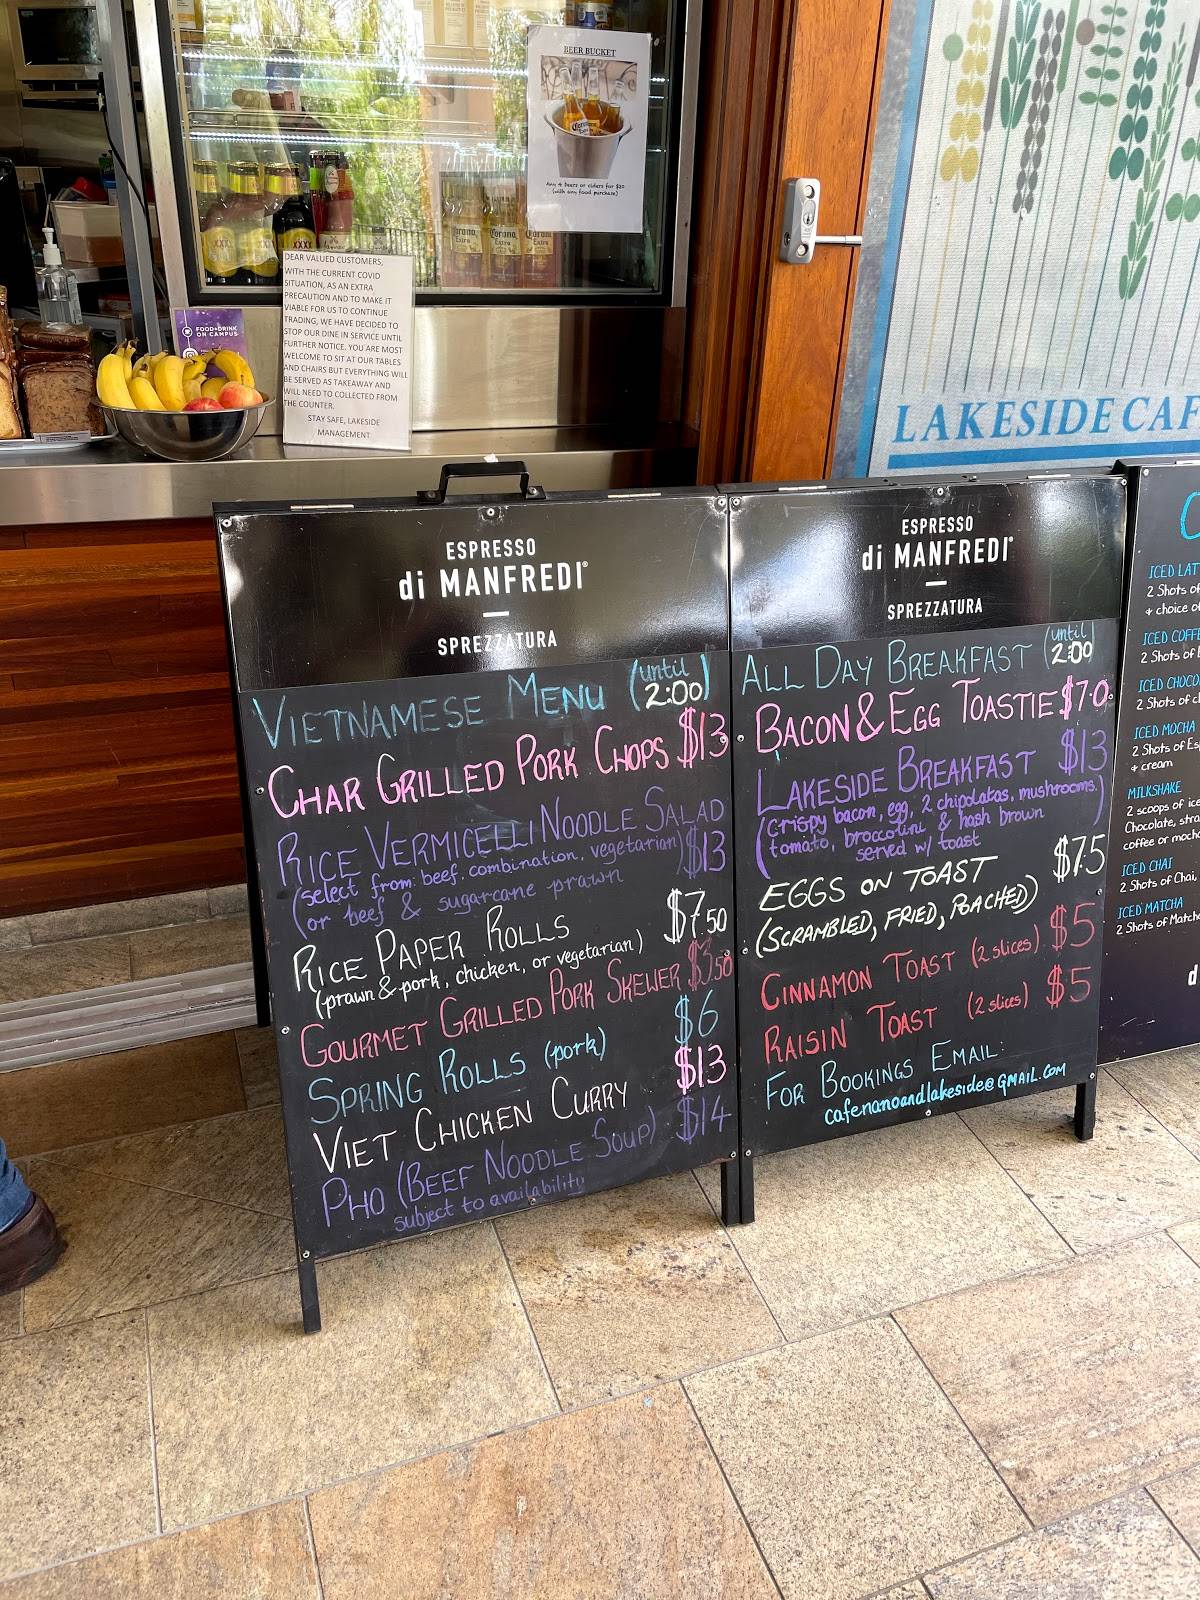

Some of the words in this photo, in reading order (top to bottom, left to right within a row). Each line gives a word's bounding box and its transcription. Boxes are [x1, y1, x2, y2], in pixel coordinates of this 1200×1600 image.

[585, 47, 617, 57] BUCKET
[284, 267, 304, 275] WITH
[322, 270, 355, 278] CURRENT
[358, 272, 381, 280] COVID
[285, 253, 304, 261] DEAR
[306, 254, 335, 263] VALUED
[337, 256, 384, 266] CUSTOMERS,
[284, 280, 325, 290] SITUATION,
[351, 283, 374, 291] EXTRA
[284, 292, 331, 301] PRECAUTION
[350, 295, 360, 303] TO
[362, 296, 383, 304] MAKE
[284, 304, 309, 312] VIABLE
[311, 305, 325, 313] FOR
[339, 307, 349, 315] TO
[350, 308, 388, 317] CONTINUE
[892, 397, 1115, 443] LAKESIDE
[902, 515, 974, 535] ESPRESSO
[446, 538, 536, 560] ESPRESSO
[862, 544, 882, 571] di
[399, 570, 425, 600] di
[887, 597, 983, 620] SPREZZATURA
[437, 629, 557, 656] SPREZZATURA
[742, 654, 804, 696] ALL
[815, 645, 873, 689] DAY
[888, 639, 1032, 683] BREAKFAST
[253, 695, 483, 749] VIETNAMESE
[507, 672, 605, 719] MENU
[756, 703, 850, 753] BACON
[856, 691, 885, 742] &
[889, 687, 941, 735] EGG
[951, 677, 1058, 724] TOASTIE
[1133, 725, 1158, 739] ICED
[1162, 720, 1195, 736] MOCHA
[268, 765, 365, 818] CHAR
[376, 753, 505, 804] GRILLED
[516, 733, 579, 785] PORK
[594, 725, 669, 774] CHOPS
[677, 706, 729, 769] $13
[757, 767, 888, 816] LAKESIDE
[898, 745, 1037, 793] BREAKFAST
[1058, 727, 1108, 777] $13
[1141, 760, 1173, 771] cream
[833, 804, 883, 824] bacon,
[887, 801, 913, 824] egg,
[921, 794, 933, 814] 2
[1126, 805, 1134, 816] 2
[1137, 804, 1170, 815] scoops
[1172, 799, 1184, 809] of
[1127, 780, 1182, 799] MILKSHAKE
[277, 831, 361, 887] RICE
[364, 820, 534, 870] VERMICELLI
[540, 796, 637, 843] NOODLE
[645, 785, 725, 832] SALAD
[590, 830, 684, 876] vegetarian)
[683, 826, 726, 879] $13
[768, 834, 835, 858] tomato,
[938, 811, 951, 832] &
[959, 807, 991, 830] hash
[999, 805, 1045, 827] brown
[855, 838, 907, 862] served
[914, 835, 932, 857] w/
[938, 829, 982, 851] toast
[759, 876, 845, 911] EGGS
[860, 871, 893, 895] ON
[902, 855, 999, 892] TOAST
[1120, 882, 1127, 893] 2
[1130, 878, 1158, 892] Shots
[1160, 875, 1172, 886] of
[1174, 871, 1197, 884] Chai,
[1121, 861, 1146, 877] ICED
[1149, 857, 1173, 872] CHAI
[307, 916, 331, 932] or
[344, 898, 386, 928] beef
[401, 891, 422, 921] &
[437, 883, 537, 915] sugarcane
[546, 868, 624, 900] prawn
[756, 909, 878, 959] (SCRAMBLED,
[884, 902, 945, 931] FRIED,
[950, 874, 1039, 920] POACHED)
[1117, 904, 1142, 920] ICED
[1145, 896, 1185, 914] MATCHA
[293, 944, 367, 993] RICE
[375, 928, 464, 975] PAPER
[486, 904, 570, 952] ROLLS
[663, 887, 728, 945] $7.50
[761, 965, 872, 1011] CINNAMON
[882, 949, 956, 983] TOAST
[971, 937, 990, 969] (2
[992, 923, 1040, 959] slices)
[1050, 902, 1096, 952] $5
[315, 989, 375, 1020] (prawn
[456, 959, 526, 984] chicken,
[532, 954, 551, 969] or
[557, 928, 643, 970] vegetarian)
[301, 1020, 427, 1068] GOURMET
[440, 996, 542, 1039] GRILLED
[549, 966, 595, 1015] PORK
[607, 958, 681, 1003] SKEWER
[764, 1018, 847, 1065] RAISIN
[866, 1000, 938, 1043] TOAST
[967, 991, 985, 1020] (2
[988, 981, 1029, 1012] slices)
[1045, 964, 1092, 1009] $5
[308, 1072, 424, 1124] SPRING
[439, 1048, 527, 1095] ROLLS
[544, 1026, 607, 1070] (pork)
[674, 989, 719, 1045] $6
[766, 1070, 805, 1110] FOR
[821, 1058, 914, 1099] BOOKINGS
[312, 1126, 398, 1174] VIET
[415, 1099, 533, 1152] CHICKEN
[551, 1076, 628, 1120] CURRY
[674, 1044, 727, 1095] $13
[321, 1177, 385, 1228] PHO
[397, 1160, 475, 1209] (BEEF
[485, 1139, 584, 1185] NOODLE
[592, 1105, 657, 1158] SOUP)
[676, 1095, 732, 1145] $14
[393, 1200, 455, 1233] subject
[461, 1196, 484, 1213] to
[489, 1171, 585, 1208] availability
